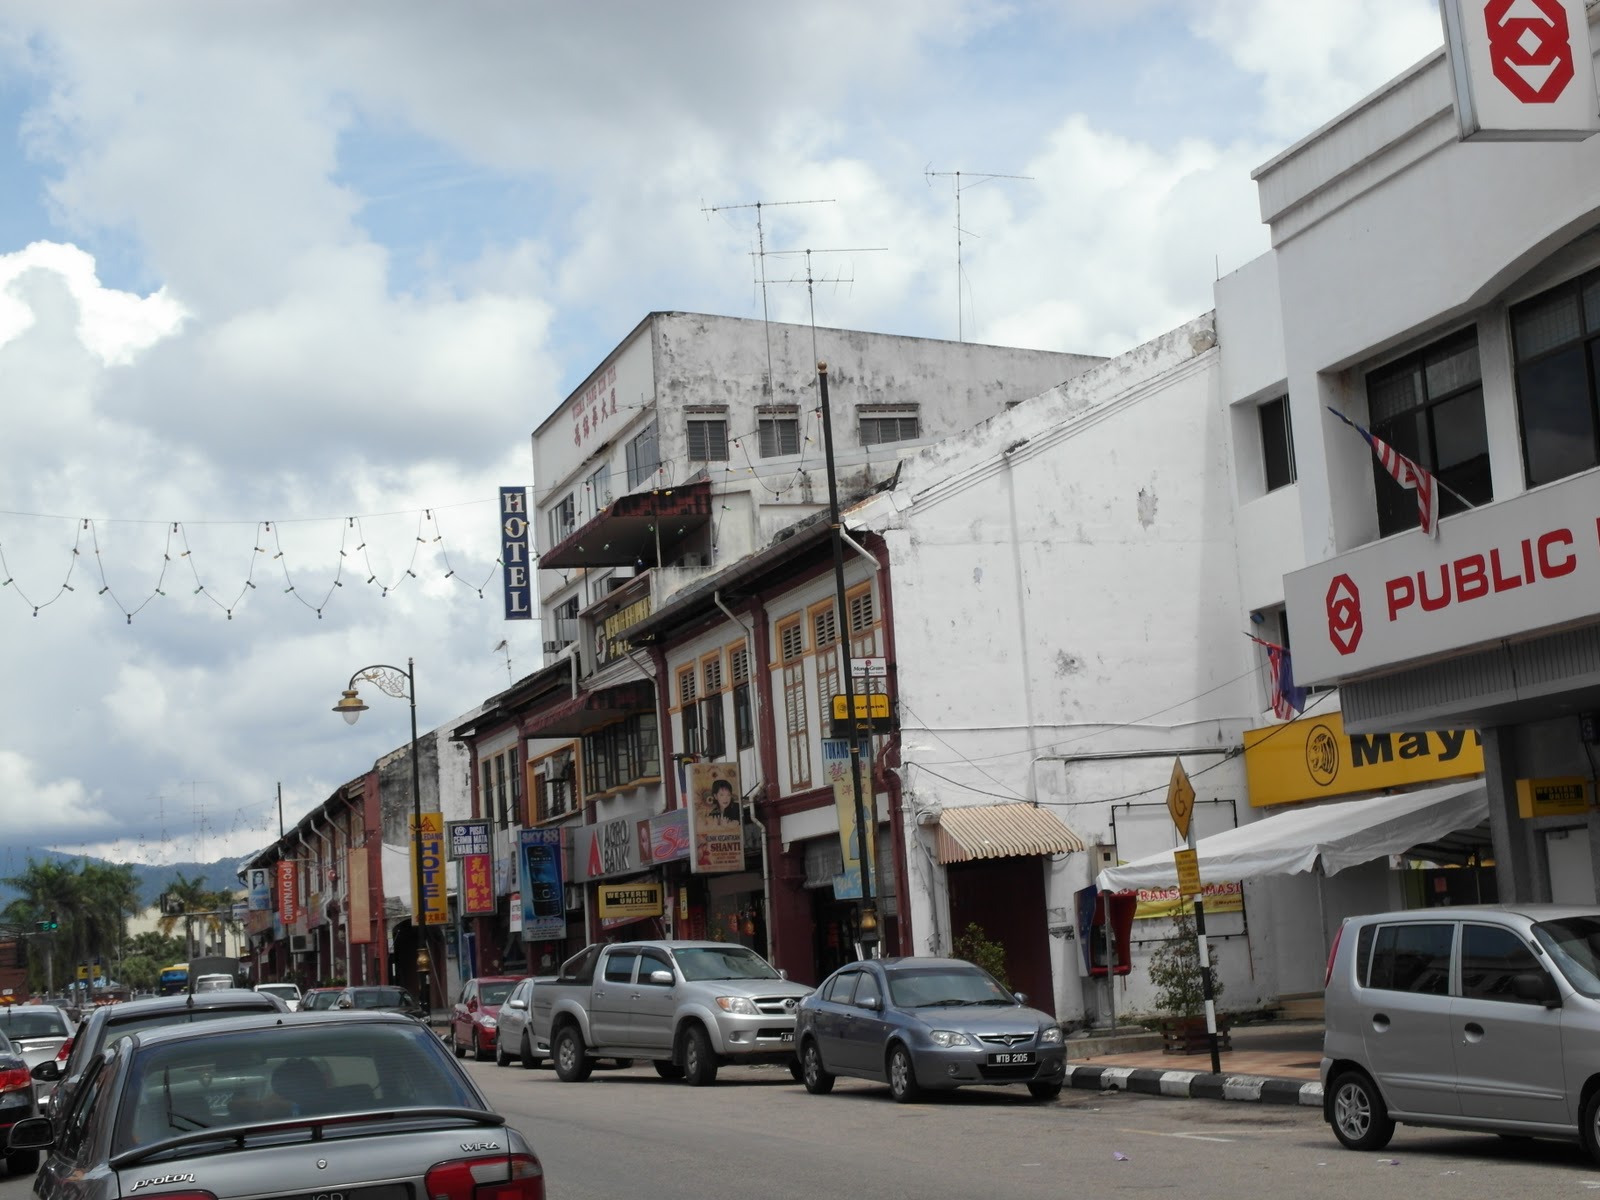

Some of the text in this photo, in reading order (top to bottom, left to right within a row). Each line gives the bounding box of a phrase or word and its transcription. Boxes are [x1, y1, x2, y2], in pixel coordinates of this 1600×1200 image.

[502, 493, 528, 613] HOTEL
[1385, 528, 1577, 622] PUBLIC
[824, 741, 849, 759] TUKANG
[1536, 786, 1575, 795] WESTERN
[1549, 792, 1575, 800] UNION
[522, 829, 559, 844] SKY 88
[710, 841, 741, 852] SHANTI
[604, 845, 631, 873] BANK
[283, 868, 293, 880] PC
[420, 841, 440, 912] HOTEL
[283, 881, 294, 921] DYNAMIC
[606, 890, 648, 899] WESTERN
[996, 1053, 1028, 1063] WTB 2105
[460, 1141, 500, 1152] WIRA
[131, 1172, 196, 1192] proton
